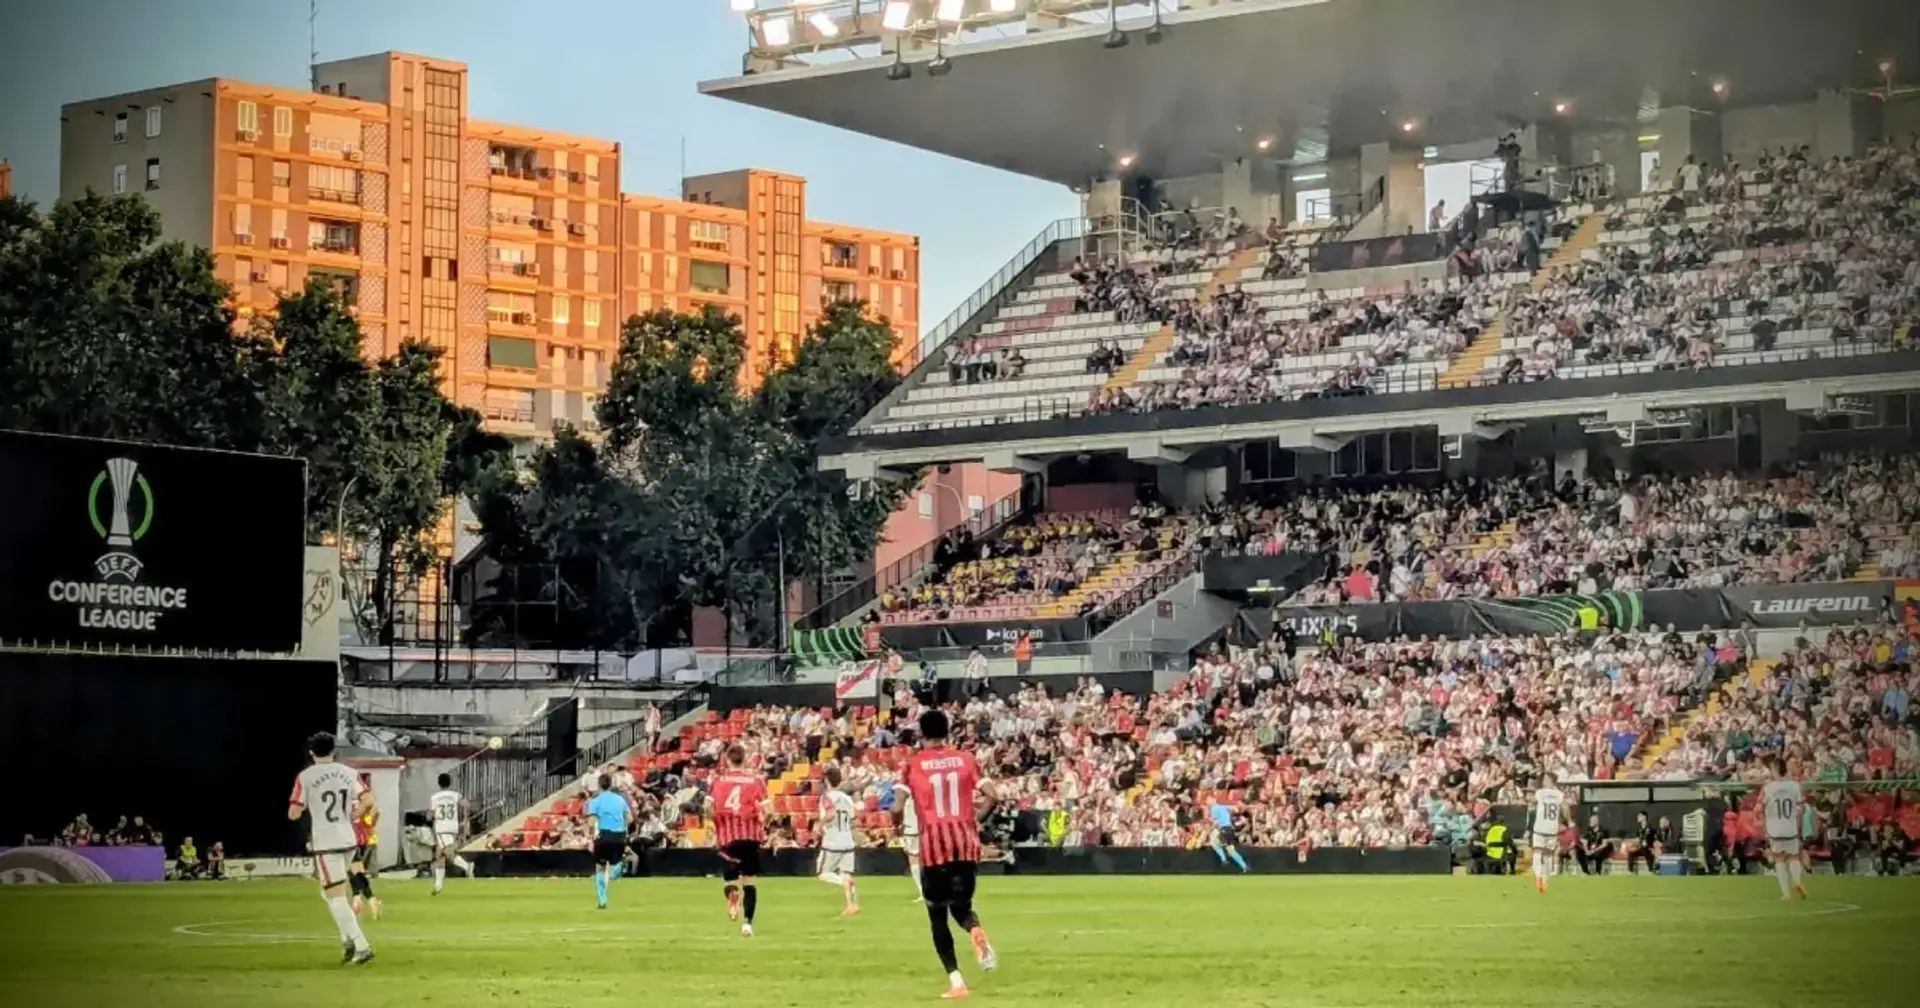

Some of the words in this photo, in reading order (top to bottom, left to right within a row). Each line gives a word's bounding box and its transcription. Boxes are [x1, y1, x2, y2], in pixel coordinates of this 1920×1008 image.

[97, 556, 140, 578] UEFA
[48, 580, 187, 608] CONFERENCE
[79, 607, 157, 630] LEAGUE
[1003, 628, 1043, 640] kaen
[920, 756, 964, 770] WEBSTER
[321, 788, 349, 823] 21
[724, 785, 742, 813] 4
[928, 771, 960, 818] 11
[1543, 802, 1558, 821] 18
[1774, 798, 1792, 820] 10
